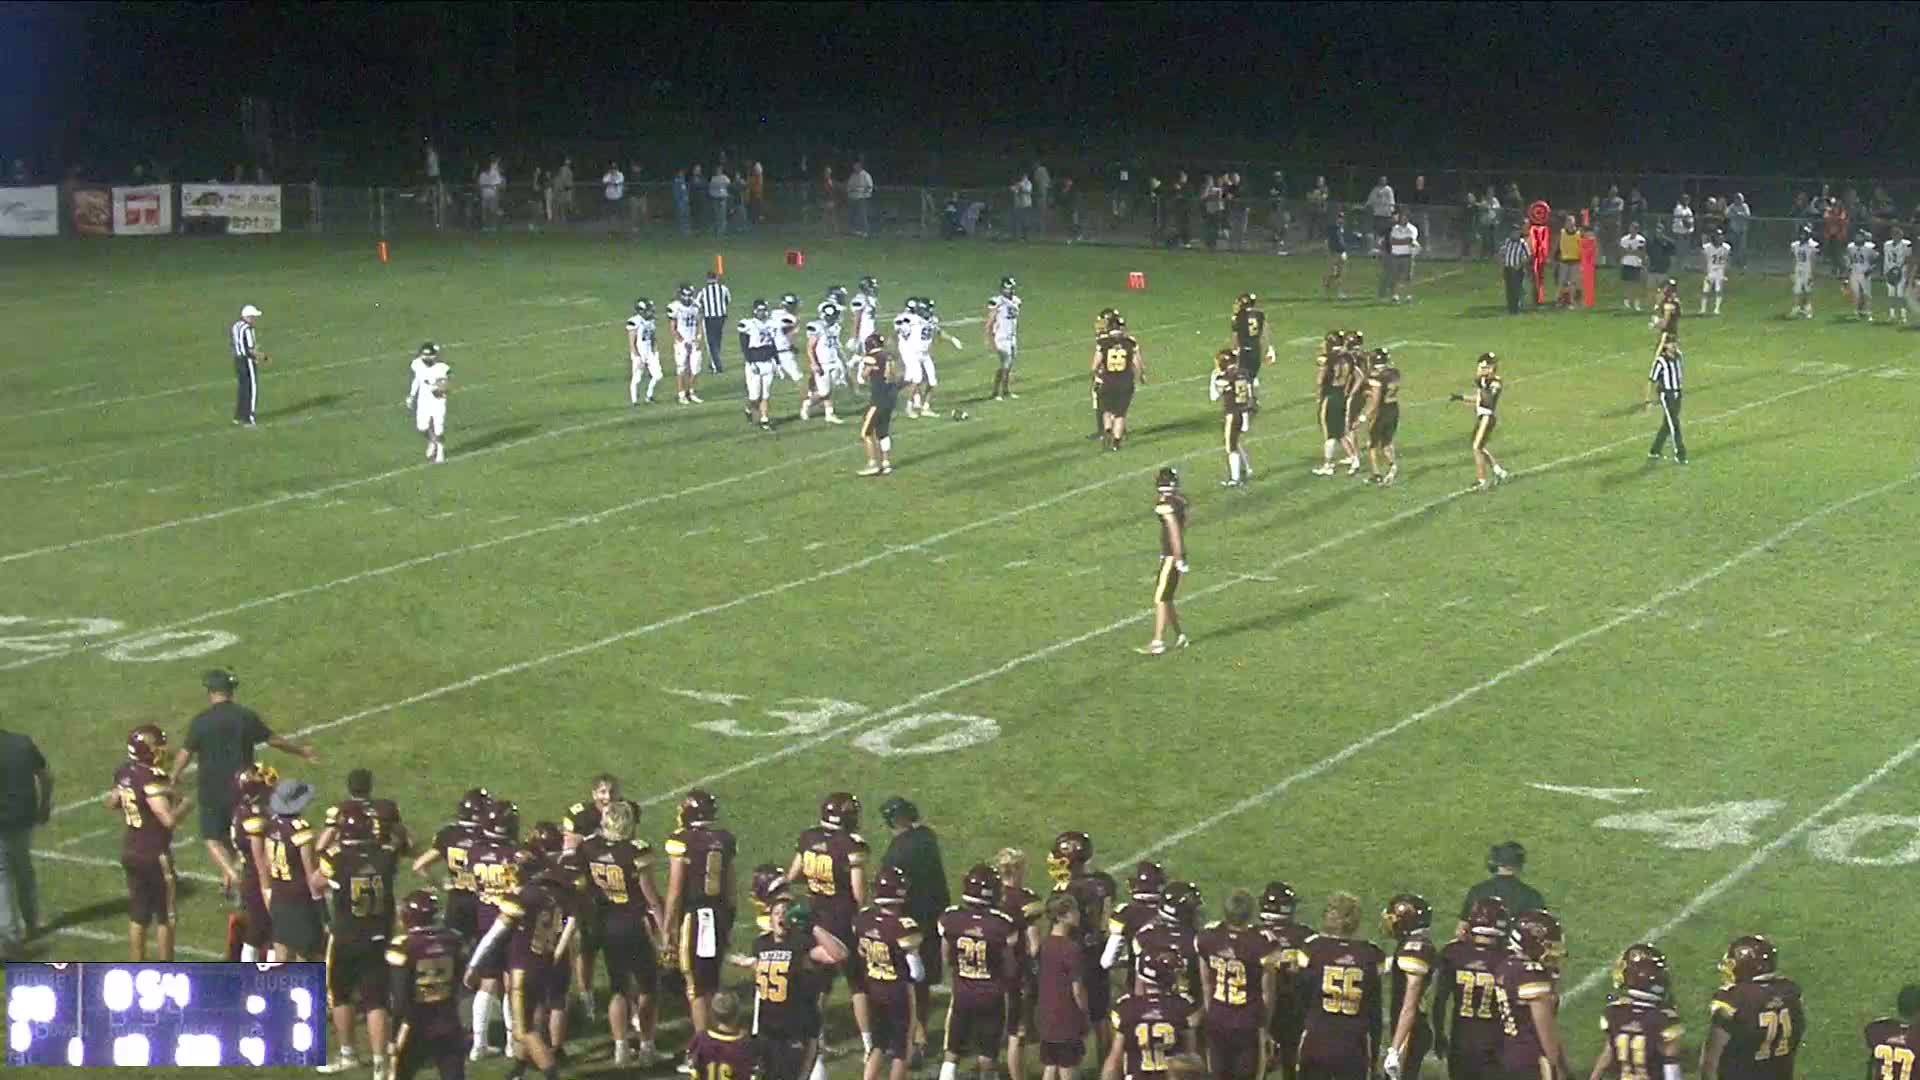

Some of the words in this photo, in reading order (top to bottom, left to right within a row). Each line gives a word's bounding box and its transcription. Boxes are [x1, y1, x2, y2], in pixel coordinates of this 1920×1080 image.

[690, 697, 1002, 757] 30
[1593, 799, 1920, 866] 40
[957, 937, 991, 980] 21
[1322, 965, 1365, 1016] 56
[1456, 969, 1495, 1018] 77
[1134, 1023, 1177, 1072] 12
[1755, 1008, 1793, 1061] 71
